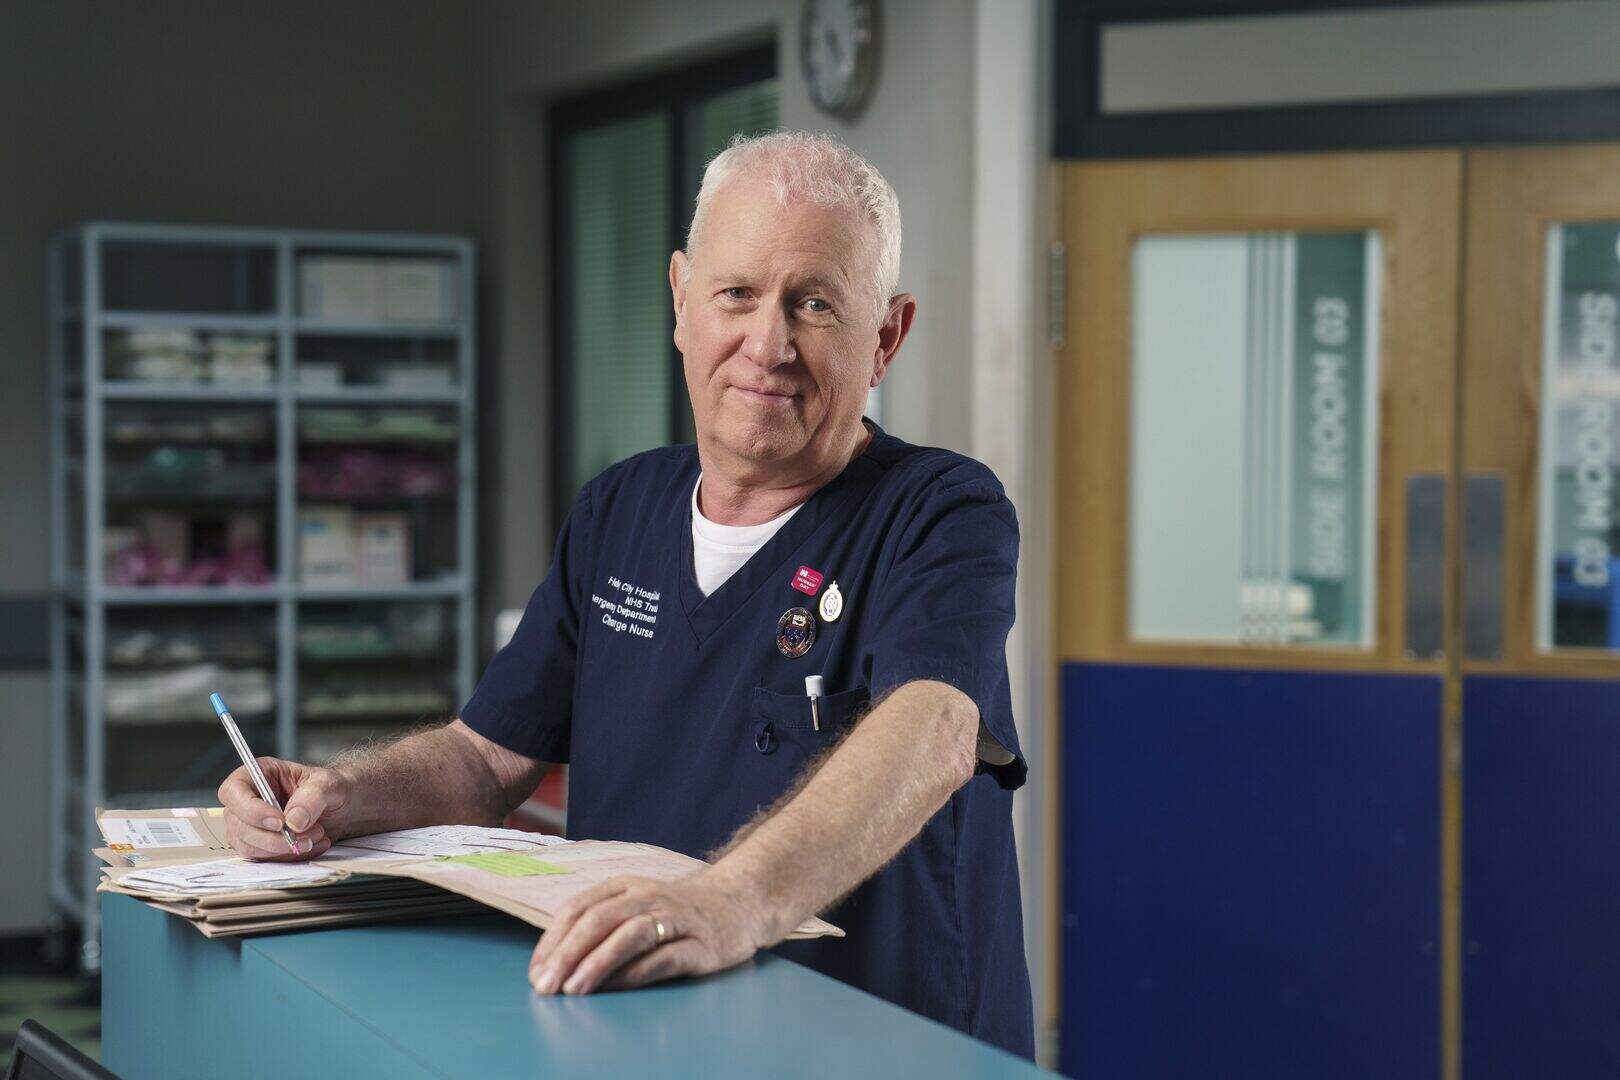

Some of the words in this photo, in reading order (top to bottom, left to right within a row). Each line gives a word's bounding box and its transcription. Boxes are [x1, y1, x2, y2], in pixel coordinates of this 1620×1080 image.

[1310, 352, 1348, 480] ROOM
[1574, 400, 1613, 530] ROOM
[602, 613, 628, 632] Charge
[628, 623, 654, 639] Nurse
[625, 596, 644, 608] NHS
